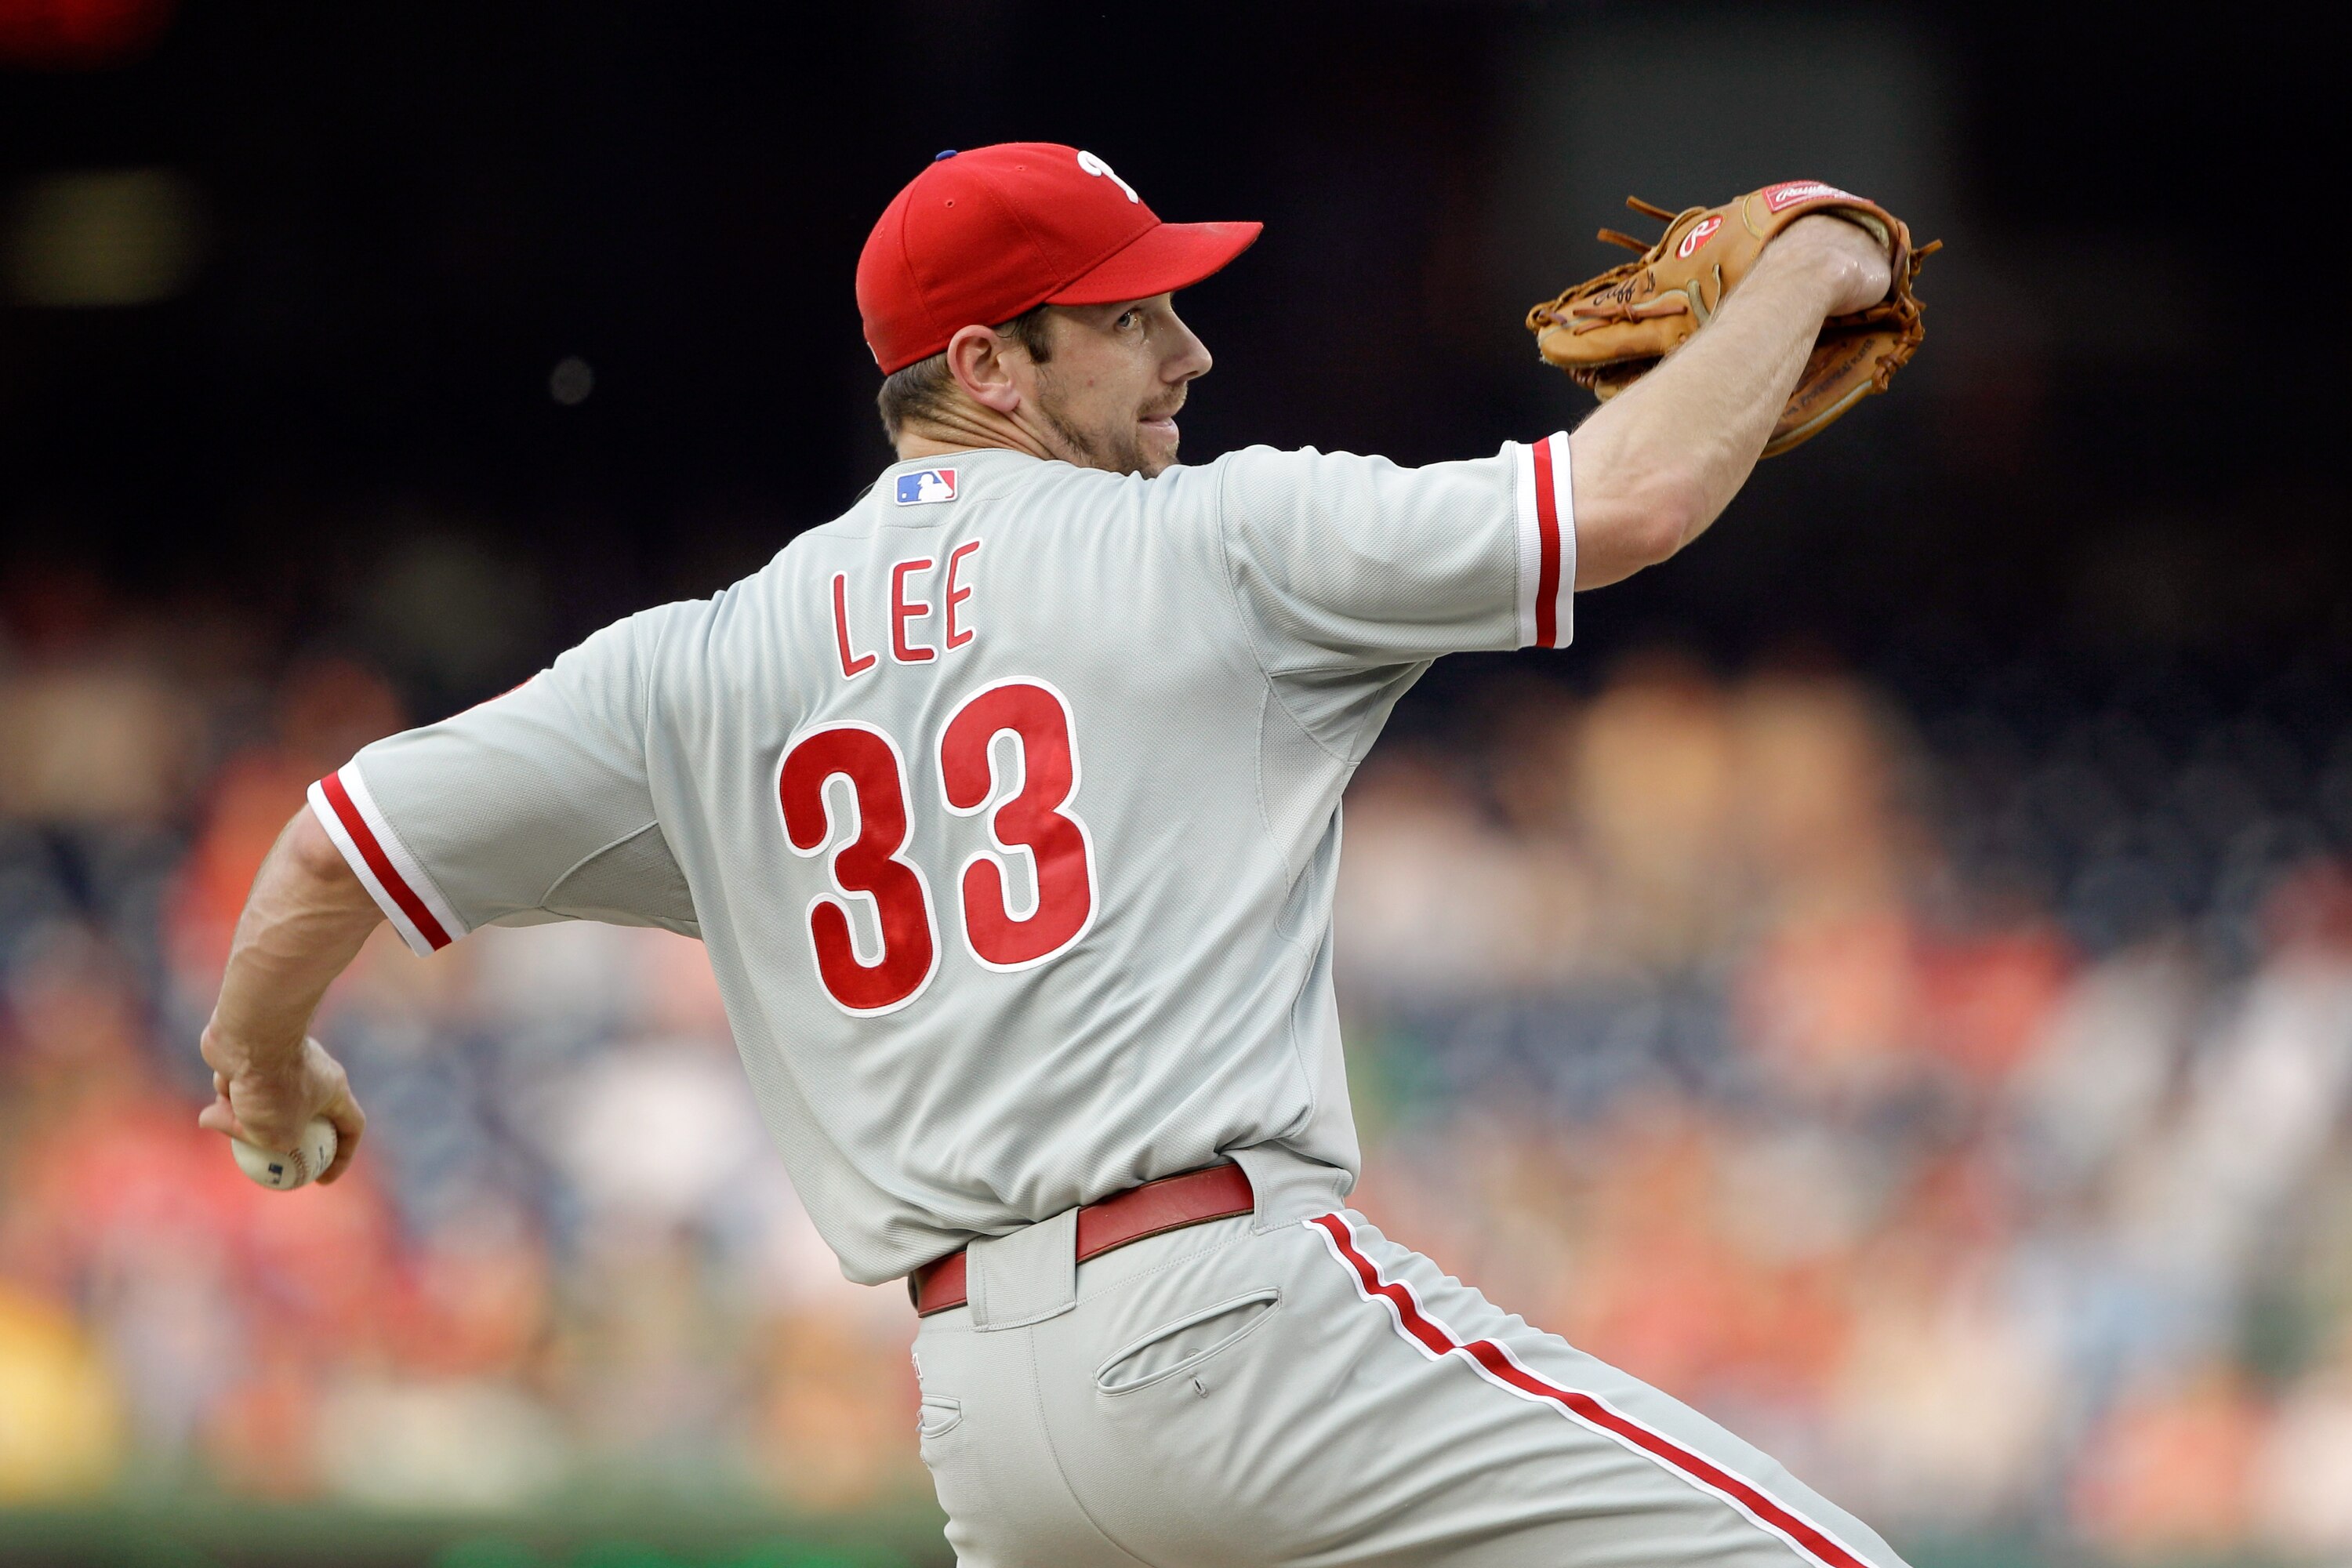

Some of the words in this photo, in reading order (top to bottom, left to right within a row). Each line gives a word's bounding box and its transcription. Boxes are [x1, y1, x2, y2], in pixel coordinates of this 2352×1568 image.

[1679, 217, 1722, 259] R
[831, 540, 981, 680] LEE
[775, 676, 1098, 1018] 33
